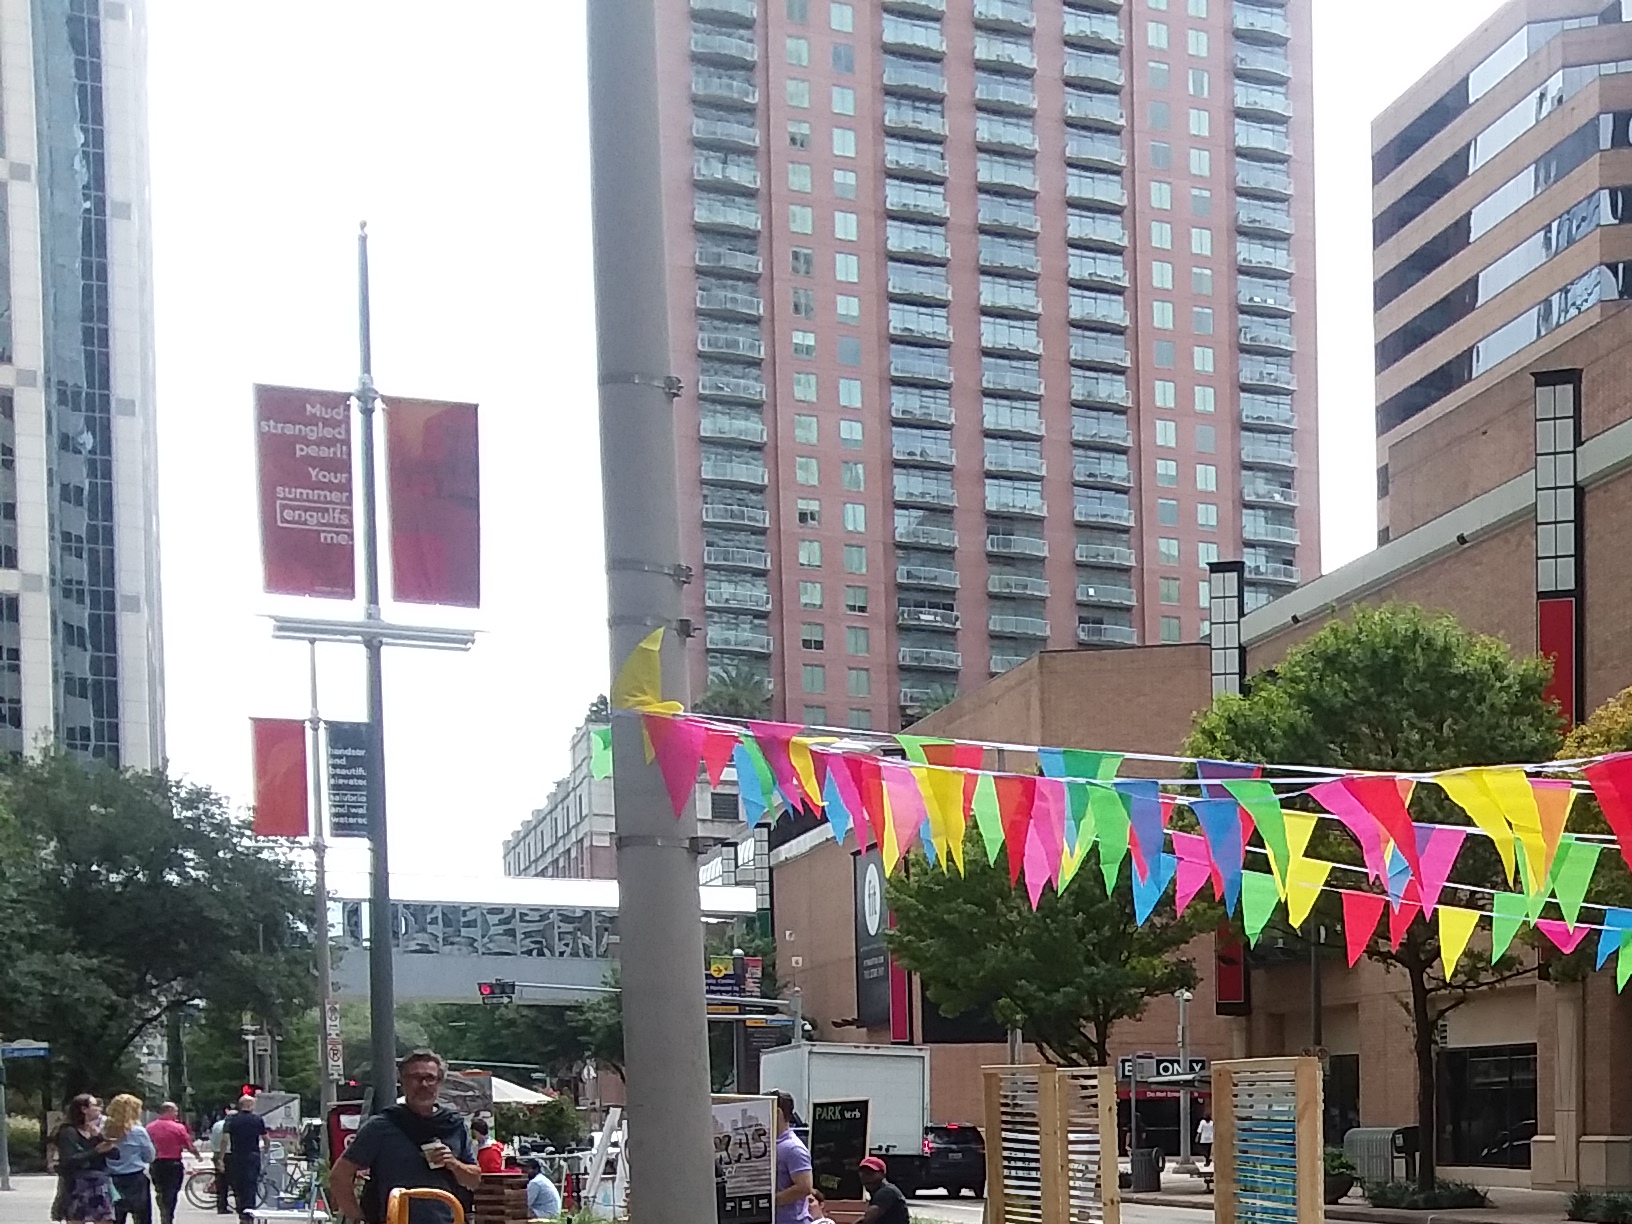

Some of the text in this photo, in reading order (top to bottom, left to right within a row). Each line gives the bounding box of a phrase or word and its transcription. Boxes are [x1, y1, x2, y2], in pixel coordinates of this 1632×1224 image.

[305, 402, 349, 419] Mud-
[260, 420, 346, 440] strangled
[308, 467, 349, 483] Your
[276, 486, 349, 502] summer
[283, 508, 349, 525] engulfs
[1159, 1062, 1203, 1076] ONY
[815, 1105, 842, 1120] PARK
